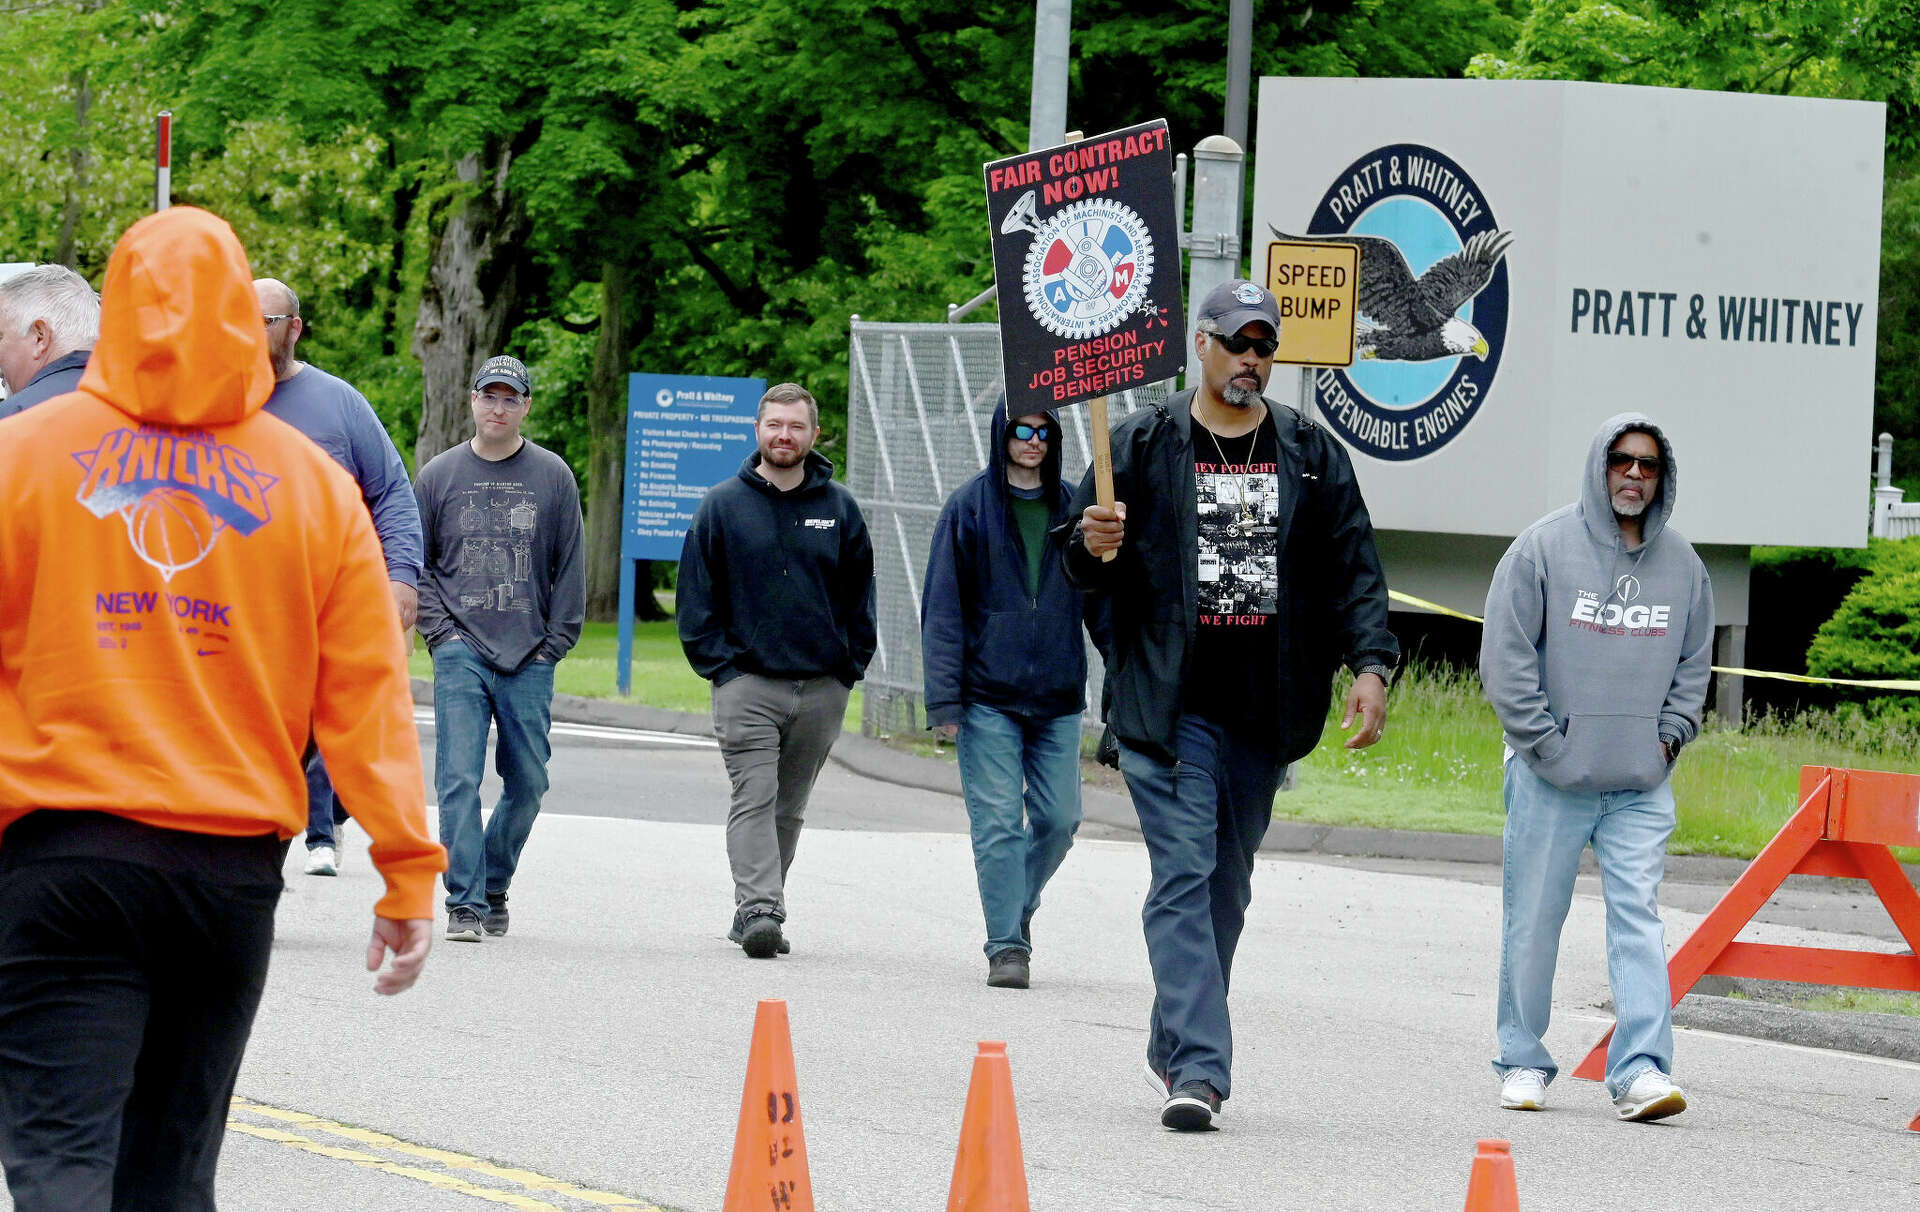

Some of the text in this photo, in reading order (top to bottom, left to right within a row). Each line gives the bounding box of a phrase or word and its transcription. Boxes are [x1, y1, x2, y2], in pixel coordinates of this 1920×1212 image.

[990, 128, 1167, 193] FAIR CONTRACT
[1043, 166, 1119, 205] NOW!
[1328, 155, 1482, 228] PRATT & WHITNEY
[1033, 208, 1145, 329] INTERNATIONAL ASSOCIATION OF MACHINISTS AND AEROSPACE WORKERS
[1115, 269, 1129, 288] M
[1278, 264, 1347, 289] SPEED
[1053, 286, 1067, 304] A
[1280, 297, 1341, 320] BUMP
[1571, 288, 1864, 347] PRATT & WHITNEY
[1054, 329, 1138, 365] PENSION
[1029, 340, 1166, 390] JOB SECURITY
[1053, 363, 1146, 401] BENEFITS
[676, 390, 735, 404] Pratt & Whitney
[1316, 368, 1478, 450] DEPENDABLE ENGINES
[633, 410, 659, 420] PRIVATE
[660, 411, 694, 421] PROPERTY
[700, 413, 710, 422] NO
[77, 427, 272, 523] KNICKS
[1221, 463, 1277, 474] FOUGHT
[95, 591, 232, 627] NEW YORK
[1577, 589, 1599, 600] THE
[1200, 614, 1267, 627] WE FIGHT
[1569, 618, 1667, 637] FITNESS CLUBS
[1571, 597, 1671, 629] EDGE
